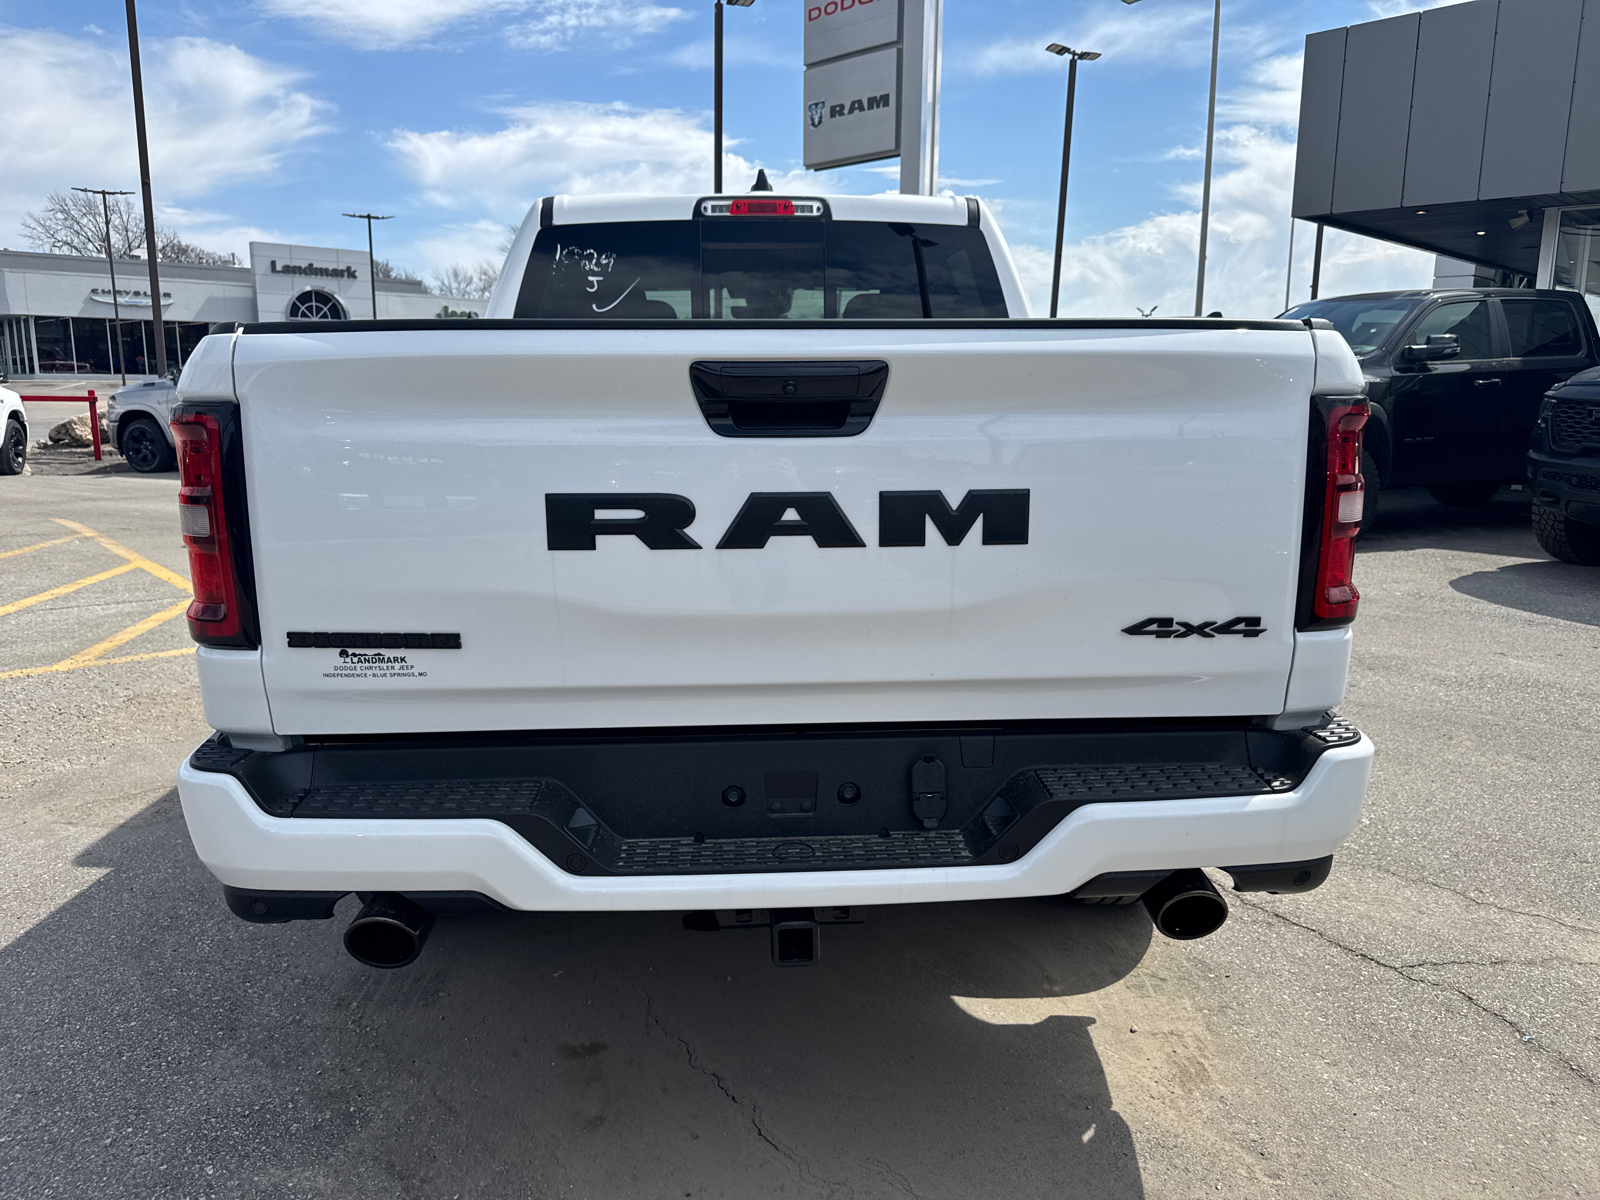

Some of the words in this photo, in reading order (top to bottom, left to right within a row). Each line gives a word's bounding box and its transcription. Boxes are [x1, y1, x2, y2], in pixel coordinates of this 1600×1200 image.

[829, 93, 890, 119] RAM
[270, 260, 358, 279] Landmark
[91, 288, 172, 298] CHRYSLR
[545, 488, 1030, 551] RAM
[1120, 616, 1268, 638] 4x4
[350, 656, 408, 664] LANDMARK
